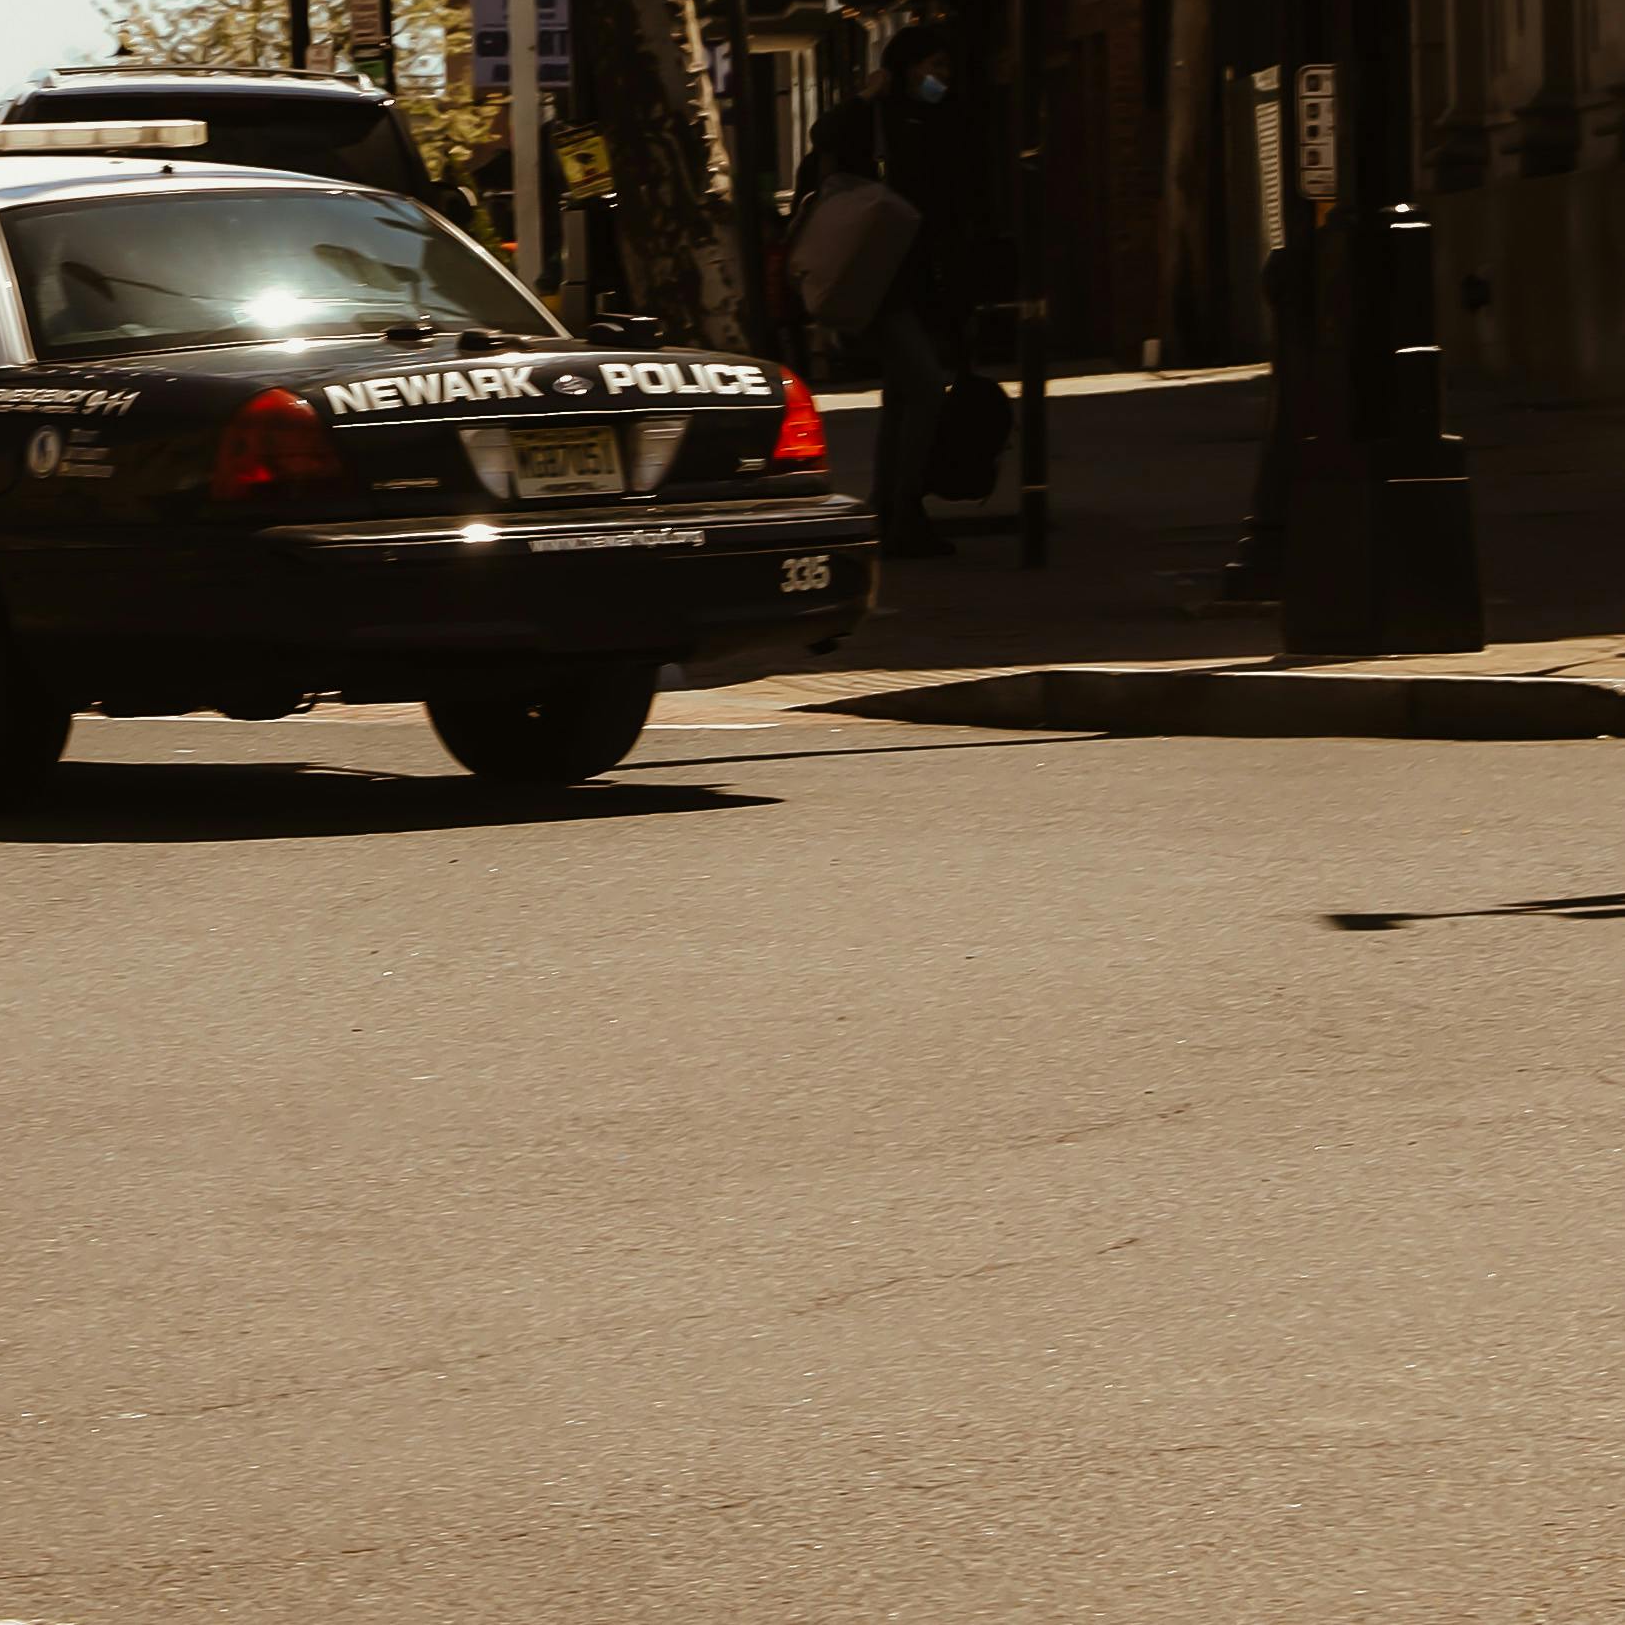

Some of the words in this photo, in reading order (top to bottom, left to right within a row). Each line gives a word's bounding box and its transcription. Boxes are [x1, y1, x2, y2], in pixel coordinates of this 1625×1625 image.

[323, 365, 543, 415] NEWARK
[598, 362, 773, 396] POLICE
[780, 556, 832, 593] 335
